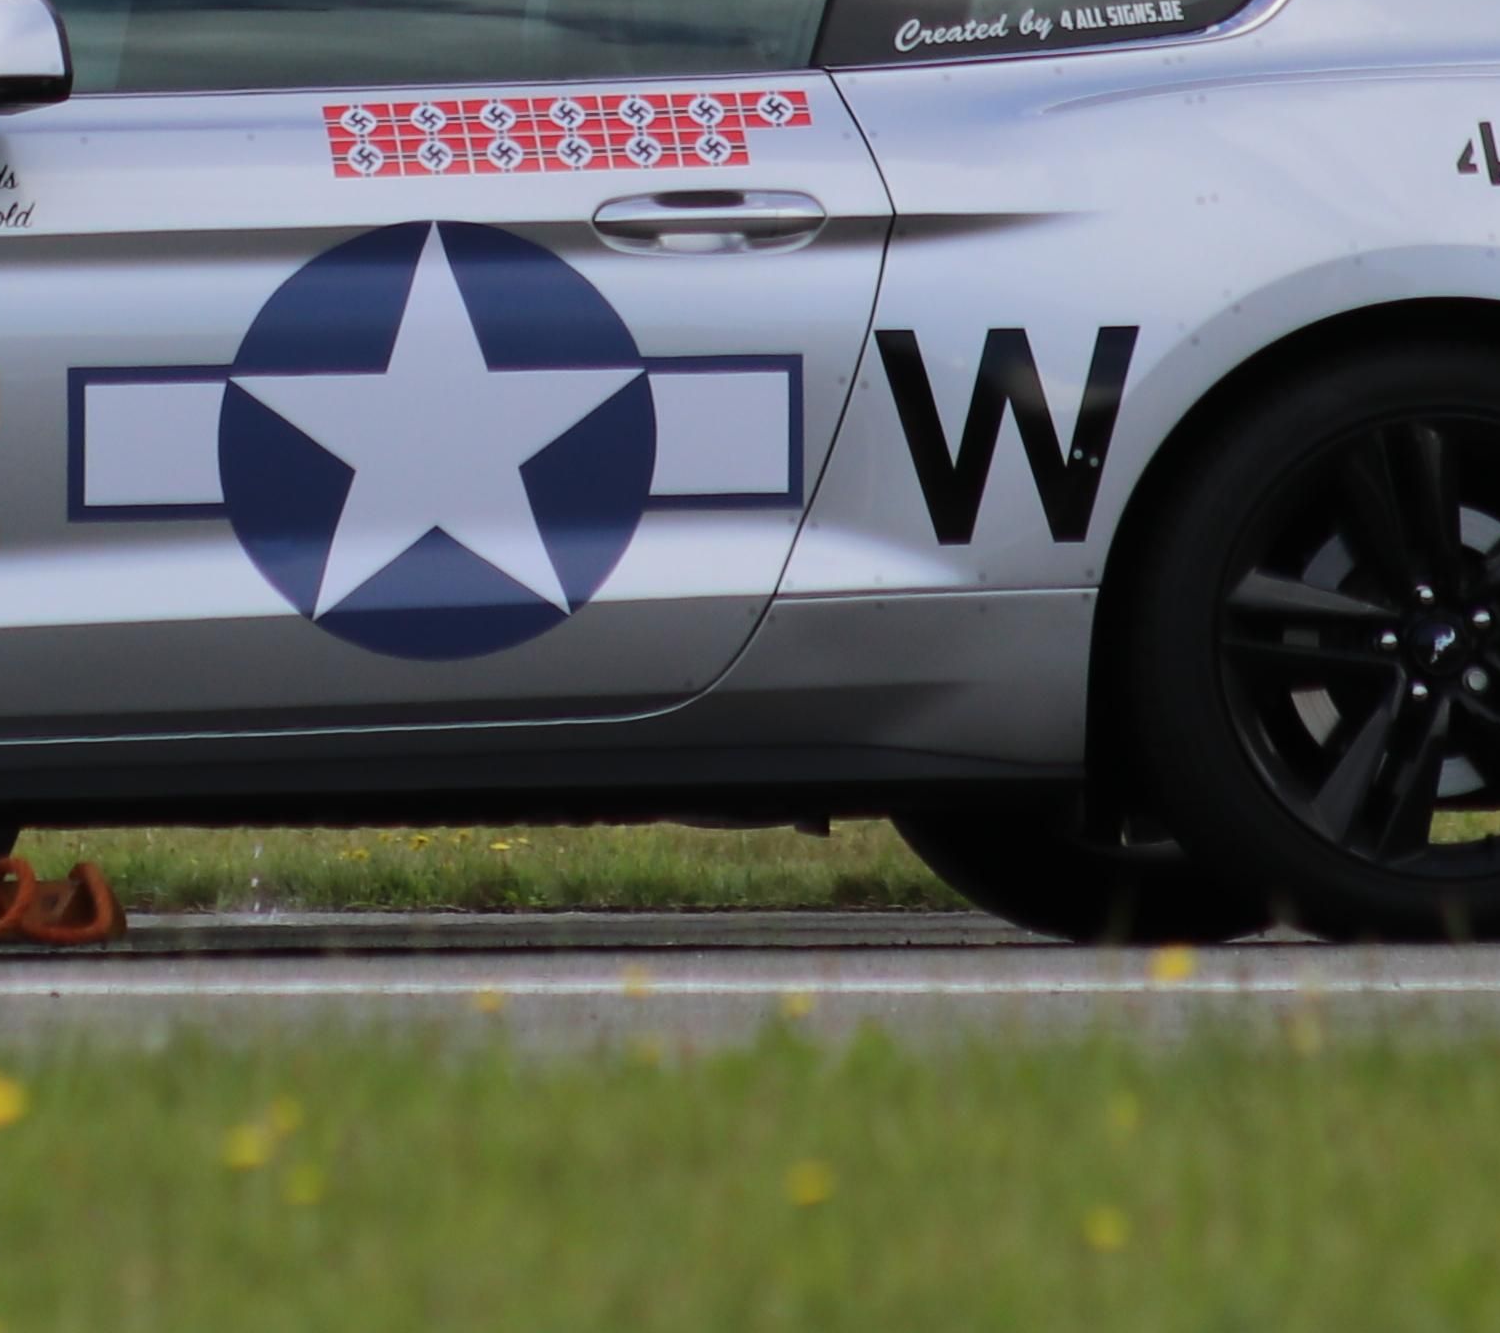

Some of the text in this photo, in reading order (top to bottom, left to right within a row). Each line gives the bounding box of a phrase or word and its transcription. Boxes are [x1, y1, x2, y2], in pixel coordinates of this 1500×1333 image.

[894, 13, 1009, 52] Created
[1018, 8, 1053, 40] by
[873, 325, 1140, 546] W
